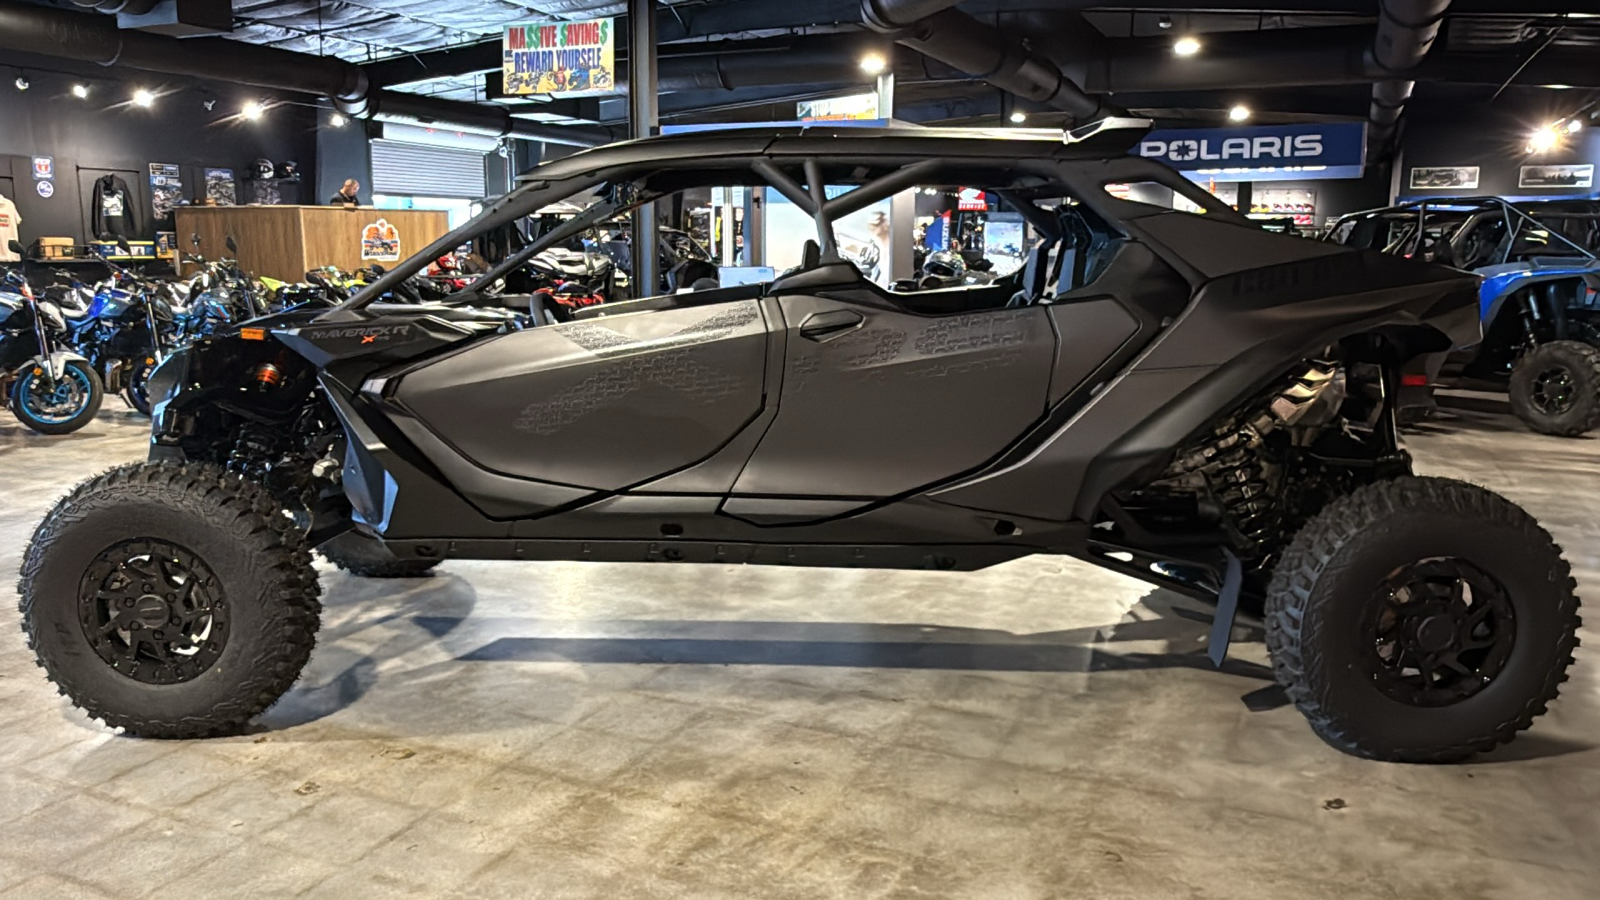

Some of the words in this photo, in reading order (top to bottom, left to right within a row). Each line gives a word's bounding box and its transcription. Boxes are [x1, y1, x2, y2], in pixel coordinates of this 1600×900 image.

[514, 50, 554, 74] REWARD
[556, 47, 602, 71] YOURSELF
[1140, 134, 1323, 161] POLARIS
[941, 216, 951, 251] SUZUK
[311, 326, 390, 340] MAVERICK
[392, 325, 410, 336] R
